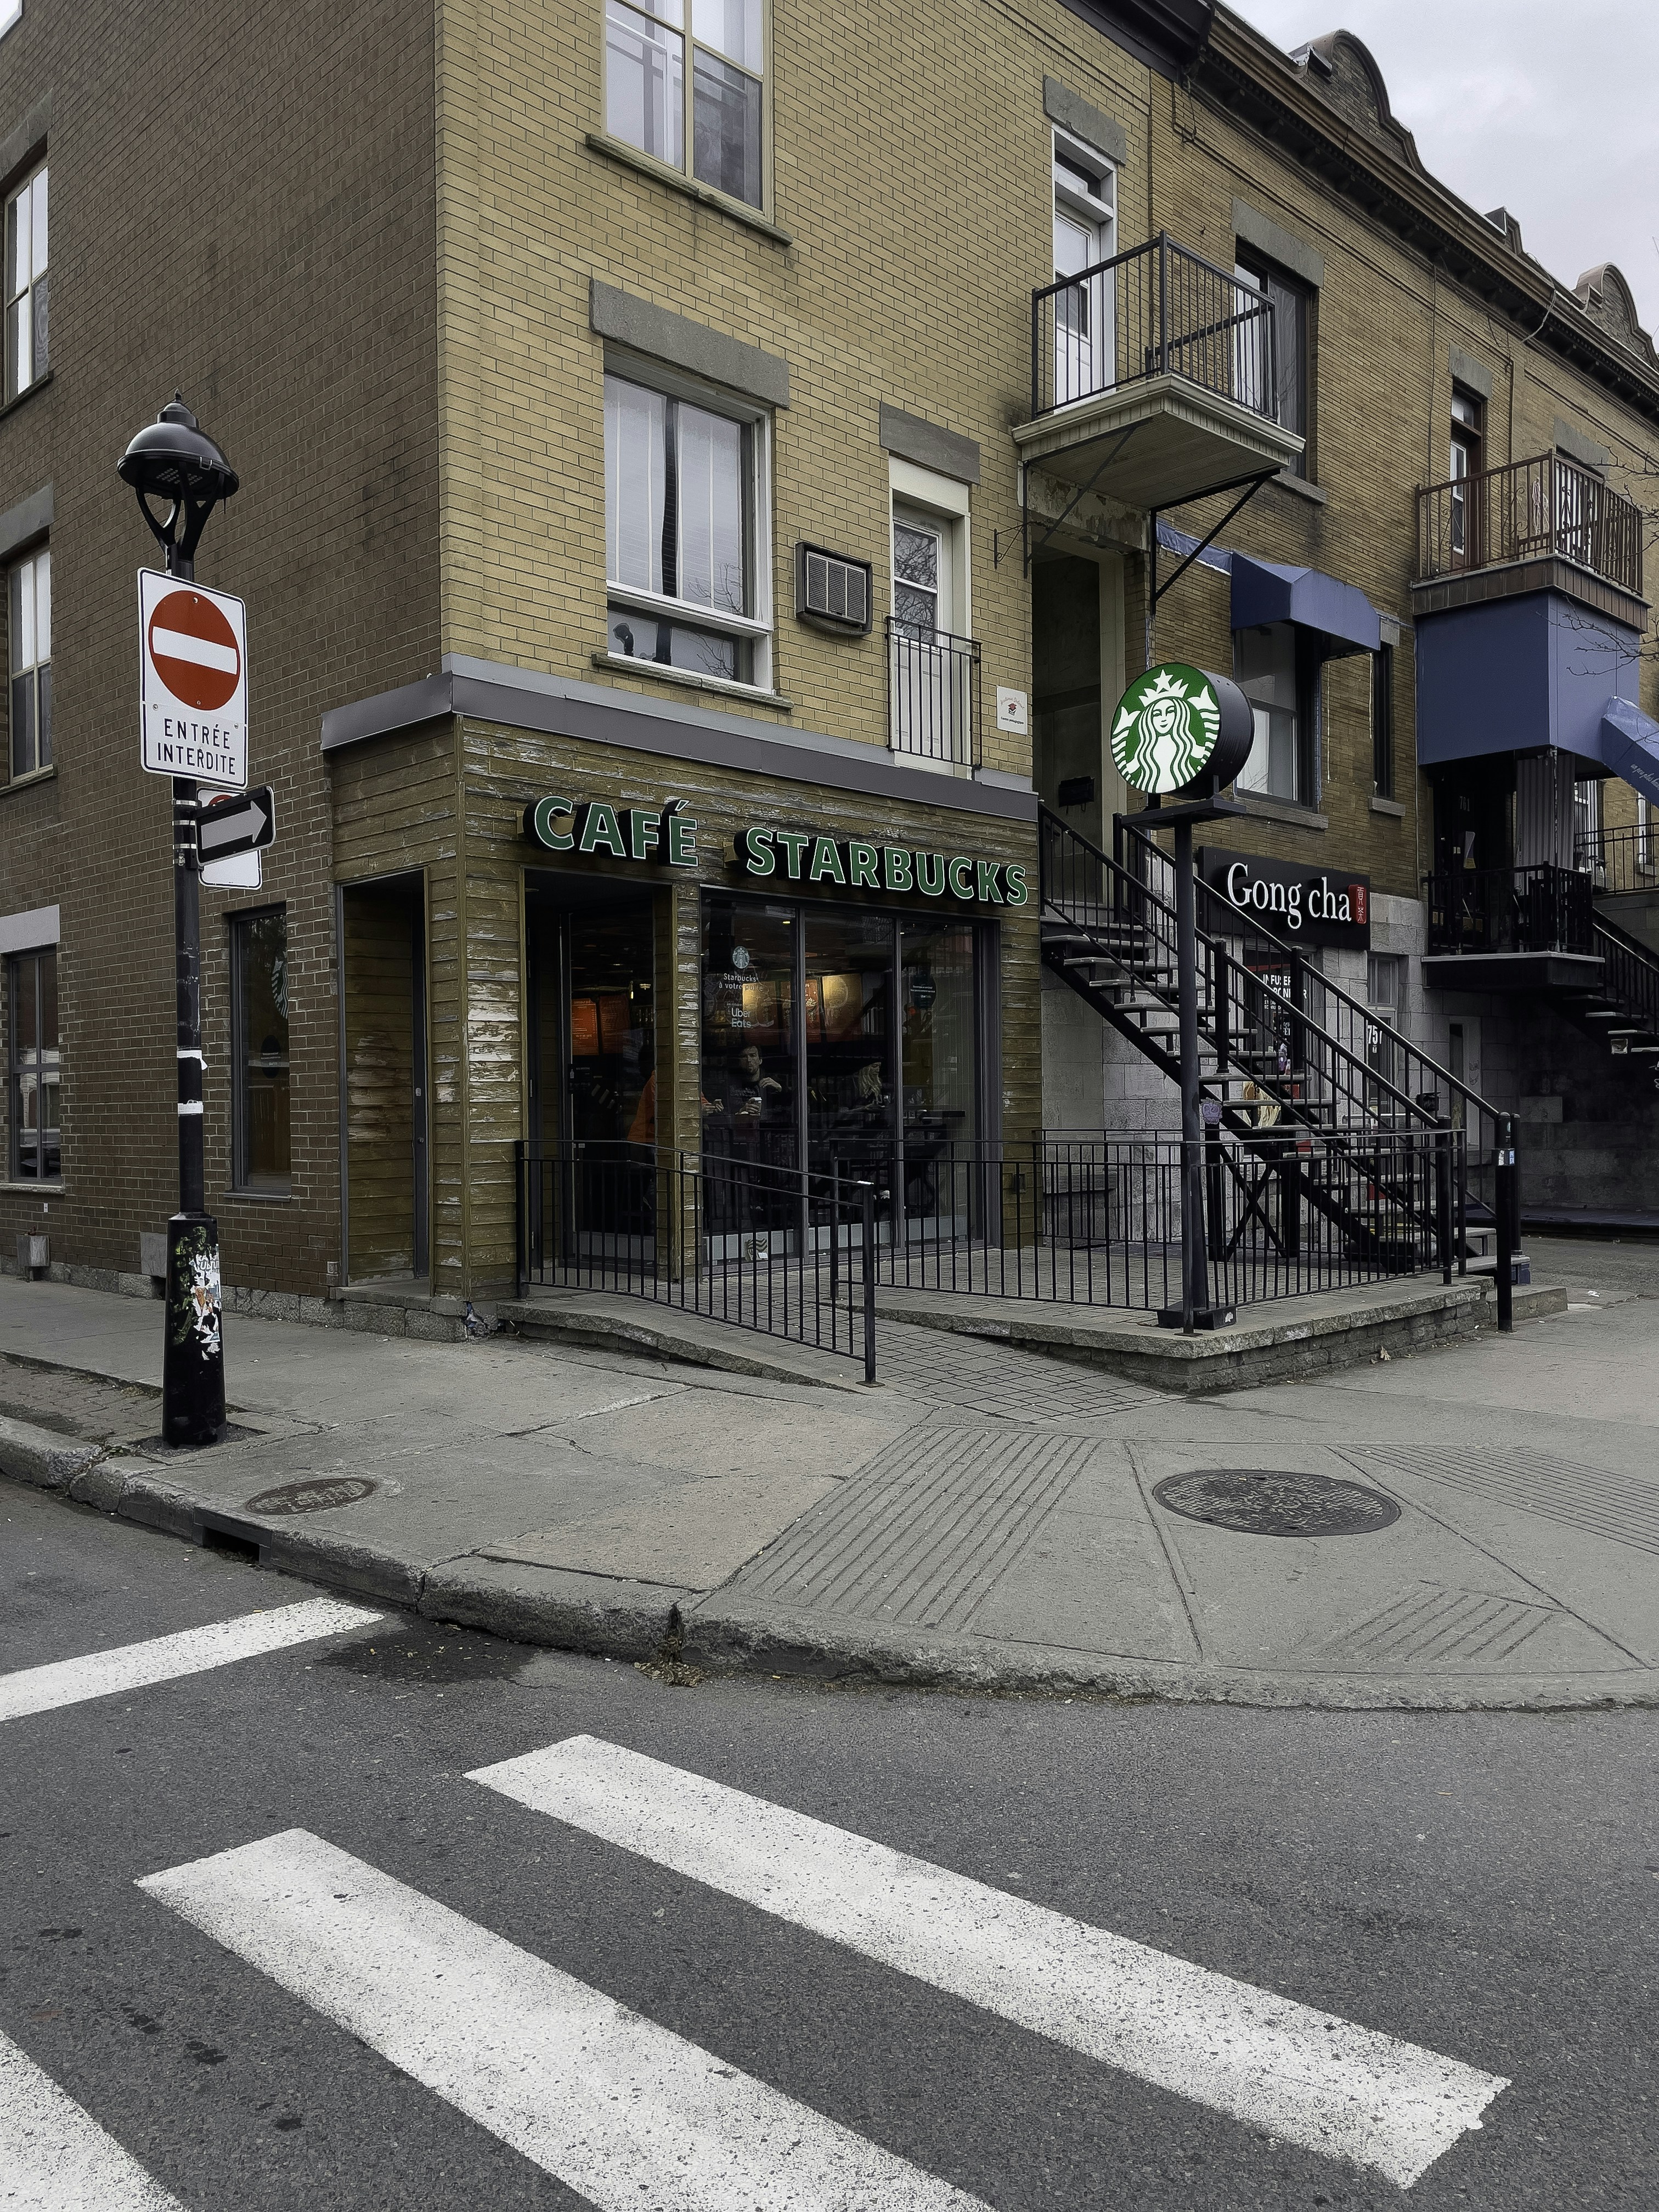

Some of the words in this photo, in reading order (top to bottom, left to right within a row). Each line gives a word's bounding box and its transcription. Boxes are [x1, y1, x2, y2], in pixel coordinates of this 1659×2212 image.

[165, 718, 230, 749] ENTRÉE
[157, 742, 235, 775] INTERDITE
[534, 795, 699, 867] CAFÉ
[746, 827, 1029, 906] STARBUCKS
[1227, 862, 1302, 929] Gong
[1308, 876, 1352, 922] cha
[723, 973, 757, 983] Starbucks
[731, 1008, 751, 1018] Uber
[731, 1018, 751, 1028] Eats
